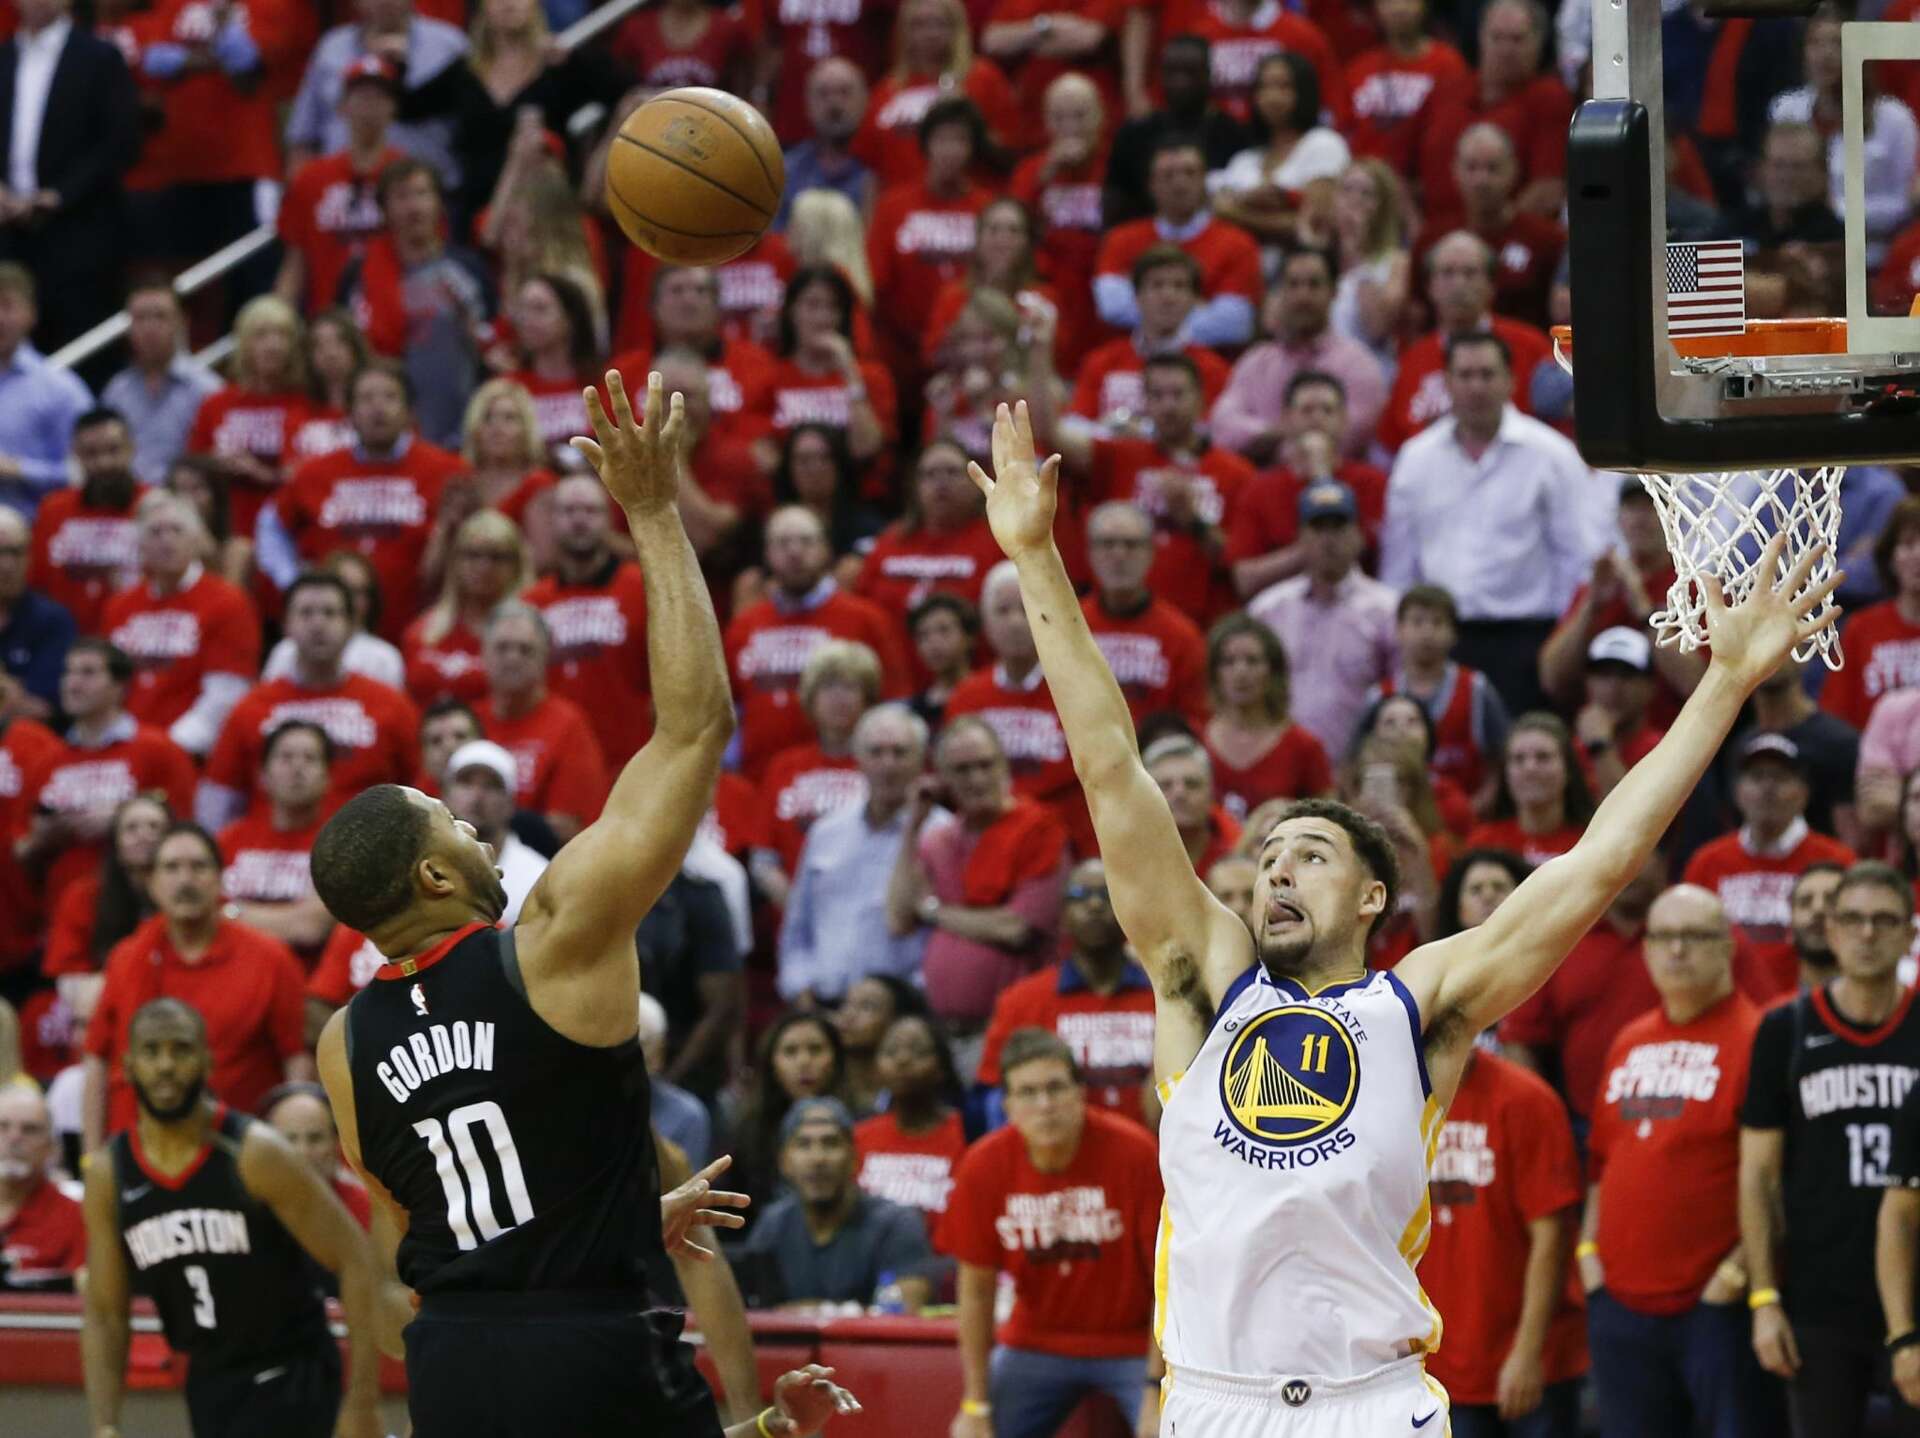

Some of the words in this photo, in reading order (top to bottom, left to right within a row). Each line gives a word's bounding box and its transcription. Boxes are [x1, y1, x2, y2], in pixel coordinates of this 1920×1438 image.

[1318, 996, 1368, 1045] STATE
[376, 1020, 495, 1103] GORDON
[1300, 1033, 1331, 1073] 11
[1621, 1041, 1719, 1068] HOUSTON
[1605, 1065, 1721, 1104] STRONG
[1799, 1063, 1920, 1119] HOUSTO
[1213, 1120, 1356, 1170] WARRIORS
[1845, 1122, 1891, 1187] 13
[412, 1101, 535, 1251] 10
[1006, 1186, 1105, 1217] HOUSTON
[124, 1207, 252, 1271] HOUSTON
[994, 1208, 1125, 1251] STRONG
[184, 1265, 217, 1329] 3
